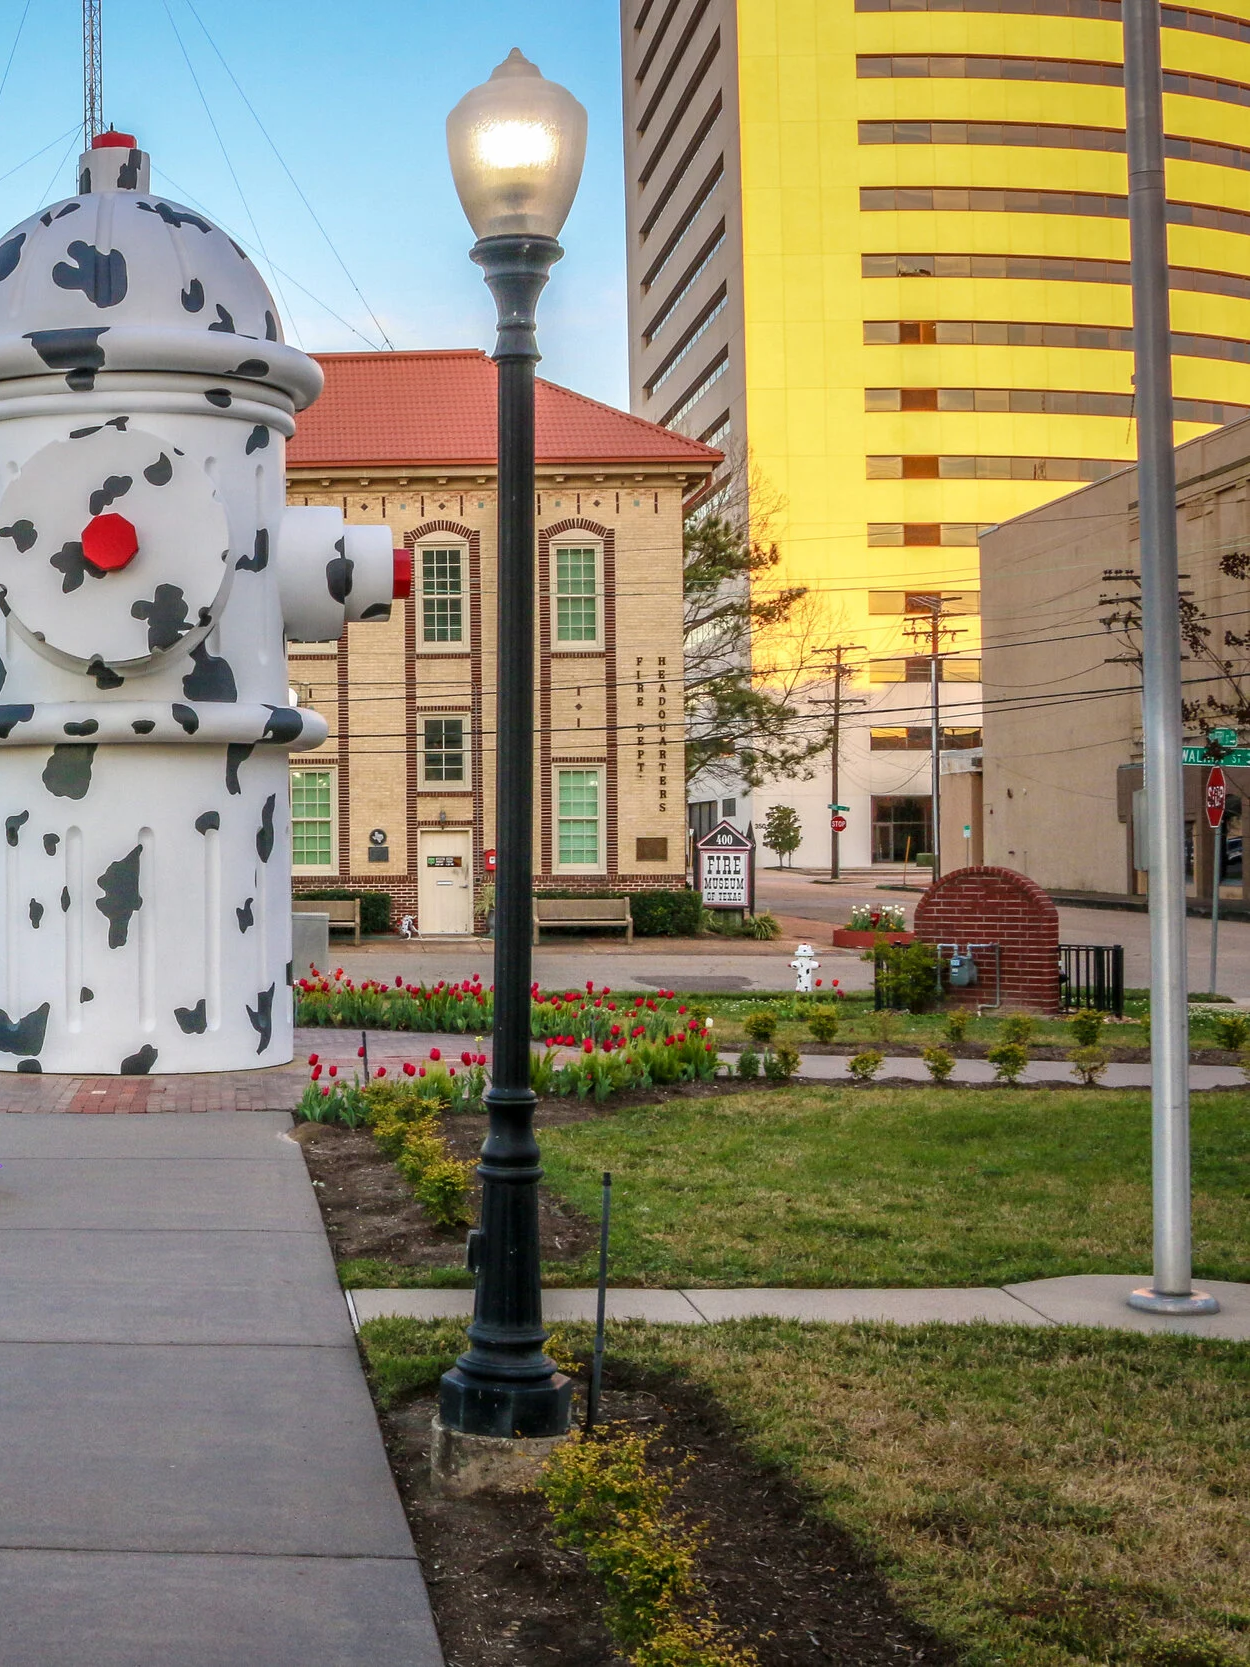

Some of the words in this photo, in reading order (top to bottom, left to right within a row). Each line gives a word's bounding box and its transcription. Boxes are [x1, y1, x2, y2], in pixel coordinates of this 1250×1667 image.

[636, 657, 644, 706] FIRE
[658, 657, 667, 812] HEADQUARTERS
[1182, 749, 1225, 764] WAL
[831, 820, 846, 828] STOP
[716, 834, 733, 845] 400
[707, 855, 741, 875] FIRE
[704, 878, 744, 889] MUSEUM
[707, 892, 715, 901] OF
[718, 892, 741, 901] TEXAS
